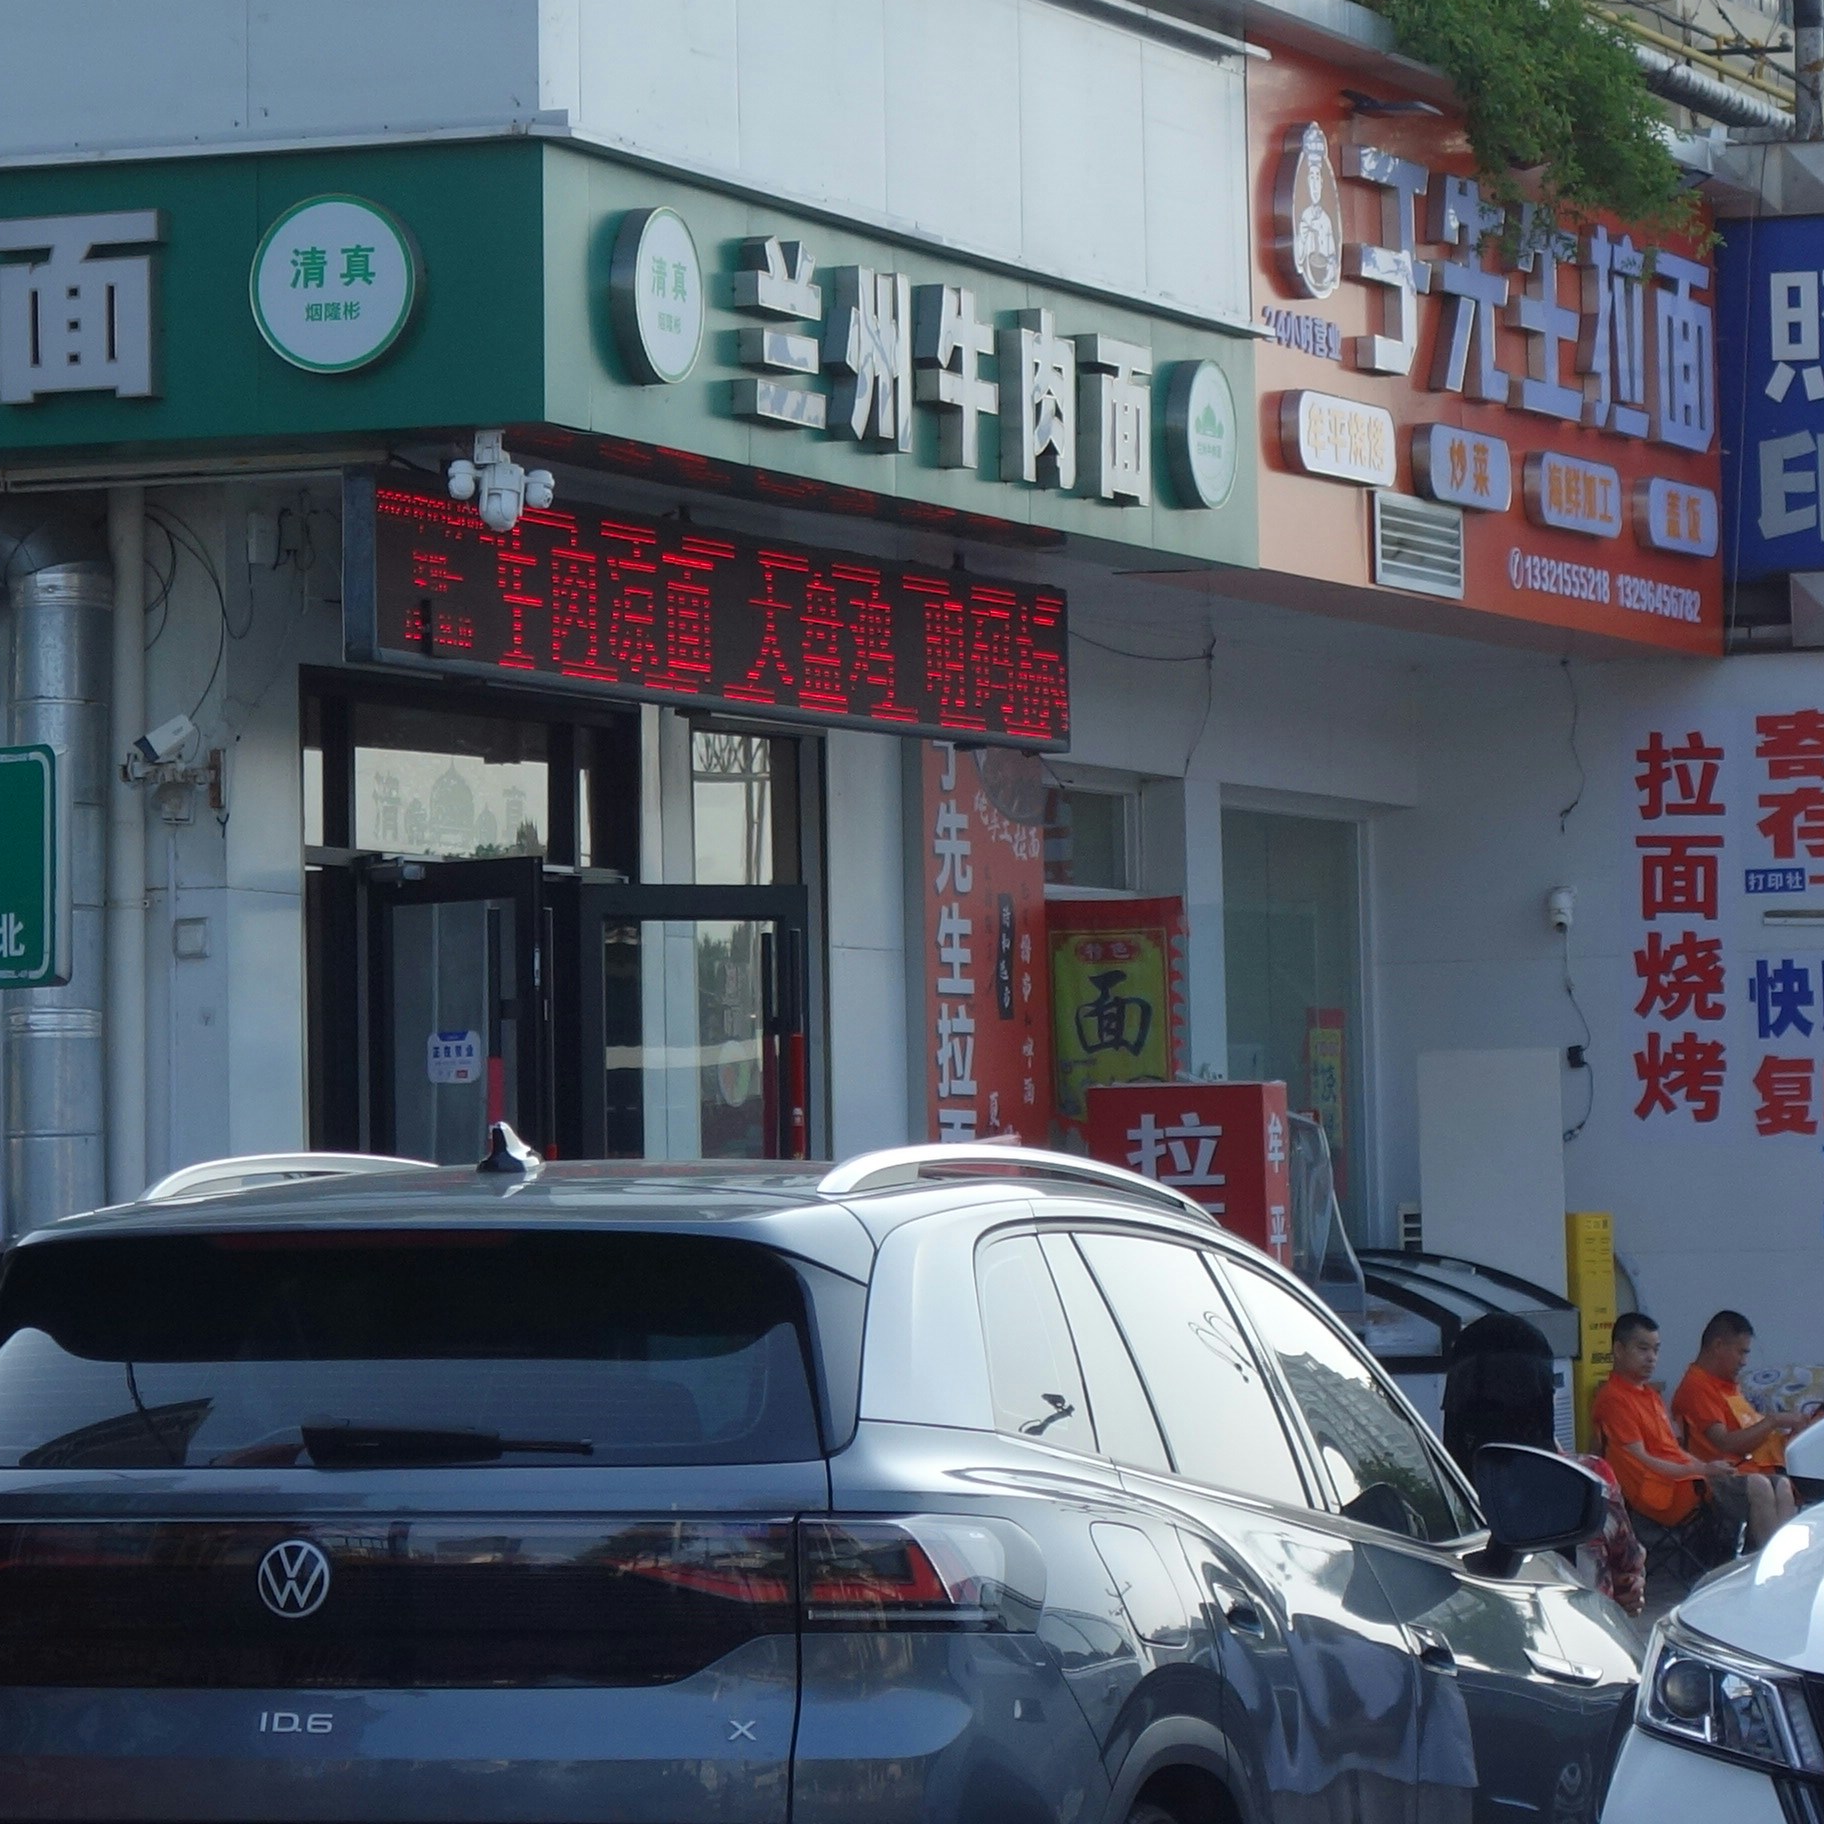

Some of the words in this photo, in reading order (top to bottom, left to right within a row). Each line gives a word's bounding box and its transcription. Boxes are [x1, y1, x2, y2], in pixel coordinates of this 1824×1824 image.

[290, 244, 376, 289] 清真
[651, 255, 688, 303] 清真
[1344, 144, 1716, 454] 于先生拉面
[732, 236, 1154, 508] 兰州牛肉面
[1524, 555, 1611, 605] 13321555218
[1747, 870, 1804, 893] 打印社
[1633, 730, 1728, 1124] 拉面烧烤
[1075, 969, 1153, 1057] 面
[1127, 1112, 1226, 1214] 拉
[728, 1720, 758, 1742] X
